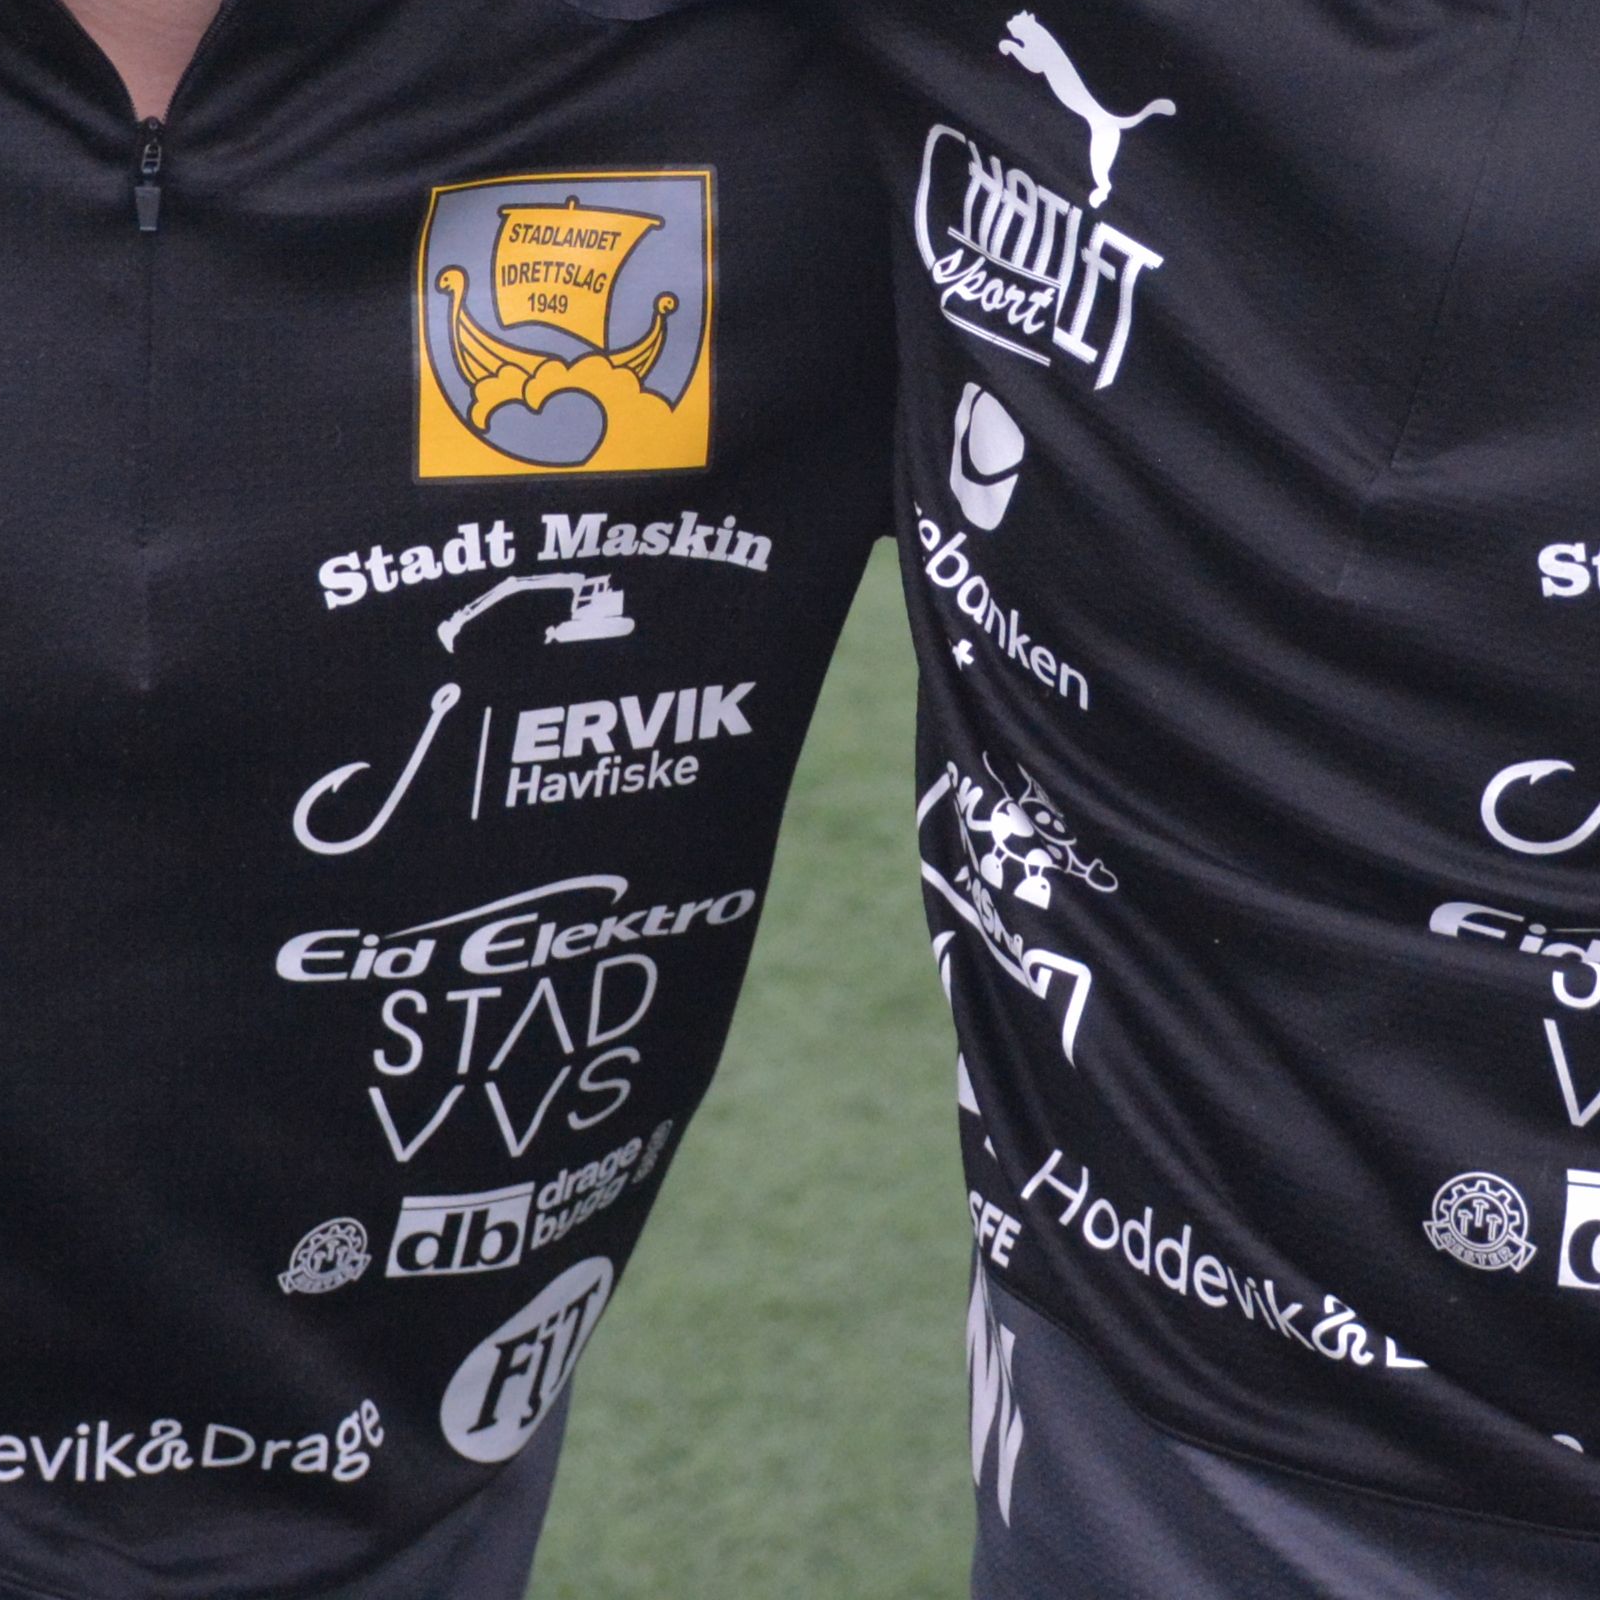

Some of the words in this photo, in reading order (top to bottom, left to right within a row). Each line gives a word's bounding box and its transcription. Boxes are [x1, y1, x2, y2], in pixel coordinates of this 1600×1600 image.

[509, 223, 621, 252] STADLANDET
[501, 261, 608, 294] IDRETTSLAG
[528, 294, 569, 314] 1949
[933, 249, 1055, 334] sport
[318, 520, 516, 610] Stadt
[537, 511, 773, 571] Maskin
[511, 681, 757, 764] ERVIK
[505, 751, 699, 808] Havfiske
[275, 929, 436, 982] Eid
[459, 888, 756, 974] Elektro
[372, 953, 658, 1075] STAD
[368, 1046, 640, 1161] VVS
[531, 1172, 629, 1250] bygg
[537, 1137, 643, 1210] drage
[397, 1209, 521, 1271] db
